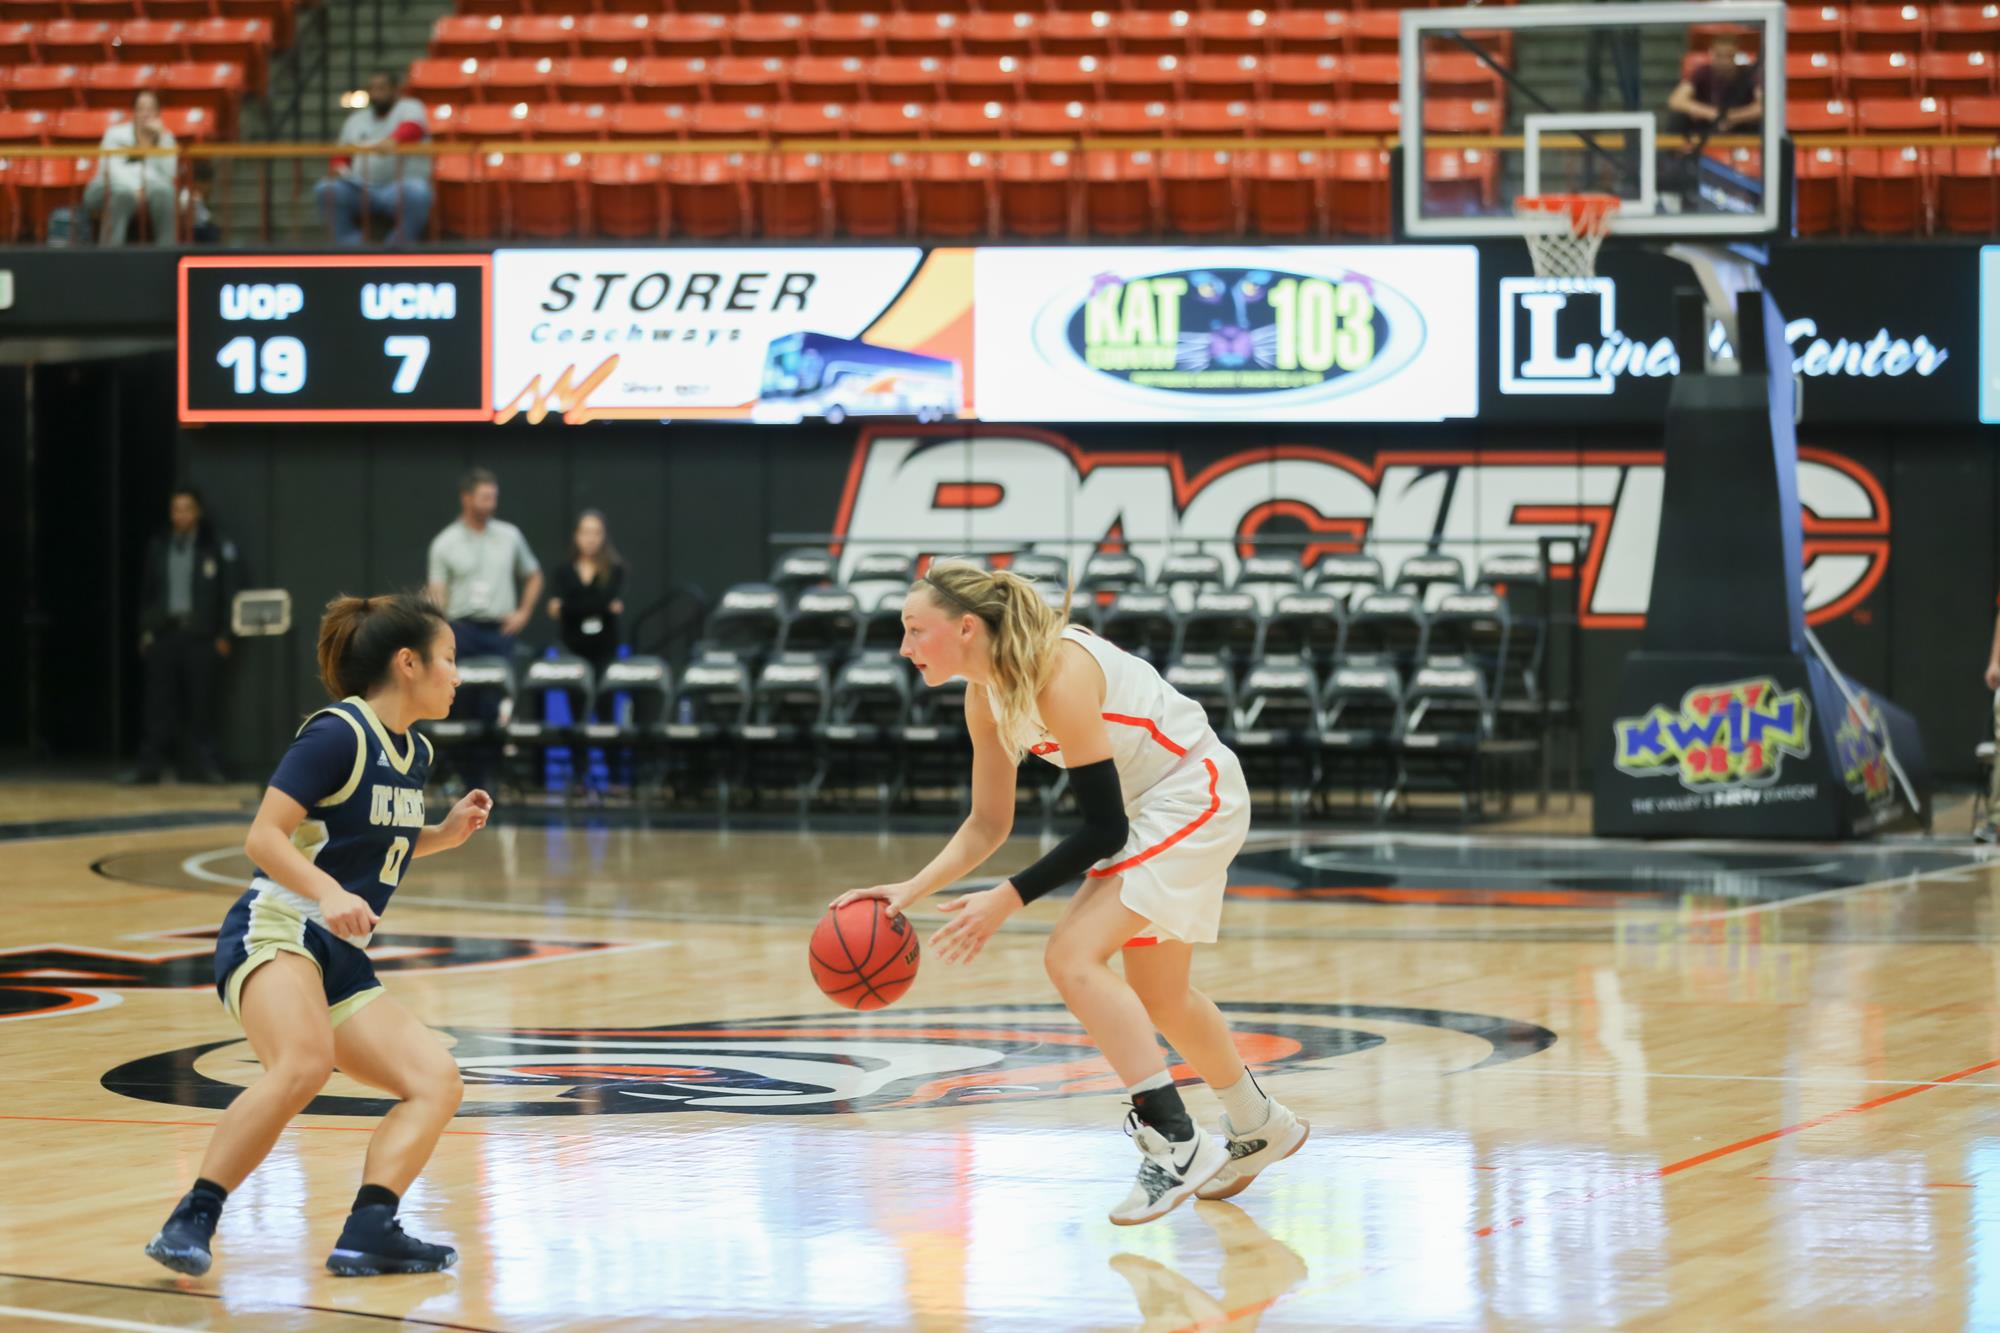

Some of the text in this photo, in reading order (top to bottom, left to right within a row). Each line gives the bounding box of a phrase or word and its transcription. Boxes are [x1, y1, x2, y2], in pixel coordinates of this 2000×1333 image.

[220, 284, 304, 320] UOP
[361, 282, 456, 320] UCM
[541, 272, 817, 313] STORER
[1085, 278, 1187, 347] KAT
[531, 323, 741, 346] Coachways
[1267, 279, 1375, 371] 103
[217, 336, 306, 394] 19
[384, 335, 430, 393] 7
[832, 424, 1891, 630] PACIFIC
[1625, 700, 1794, 755] KWIN
[370, 784, 393, 826] UC
[379, 836, 410, 886] 0
